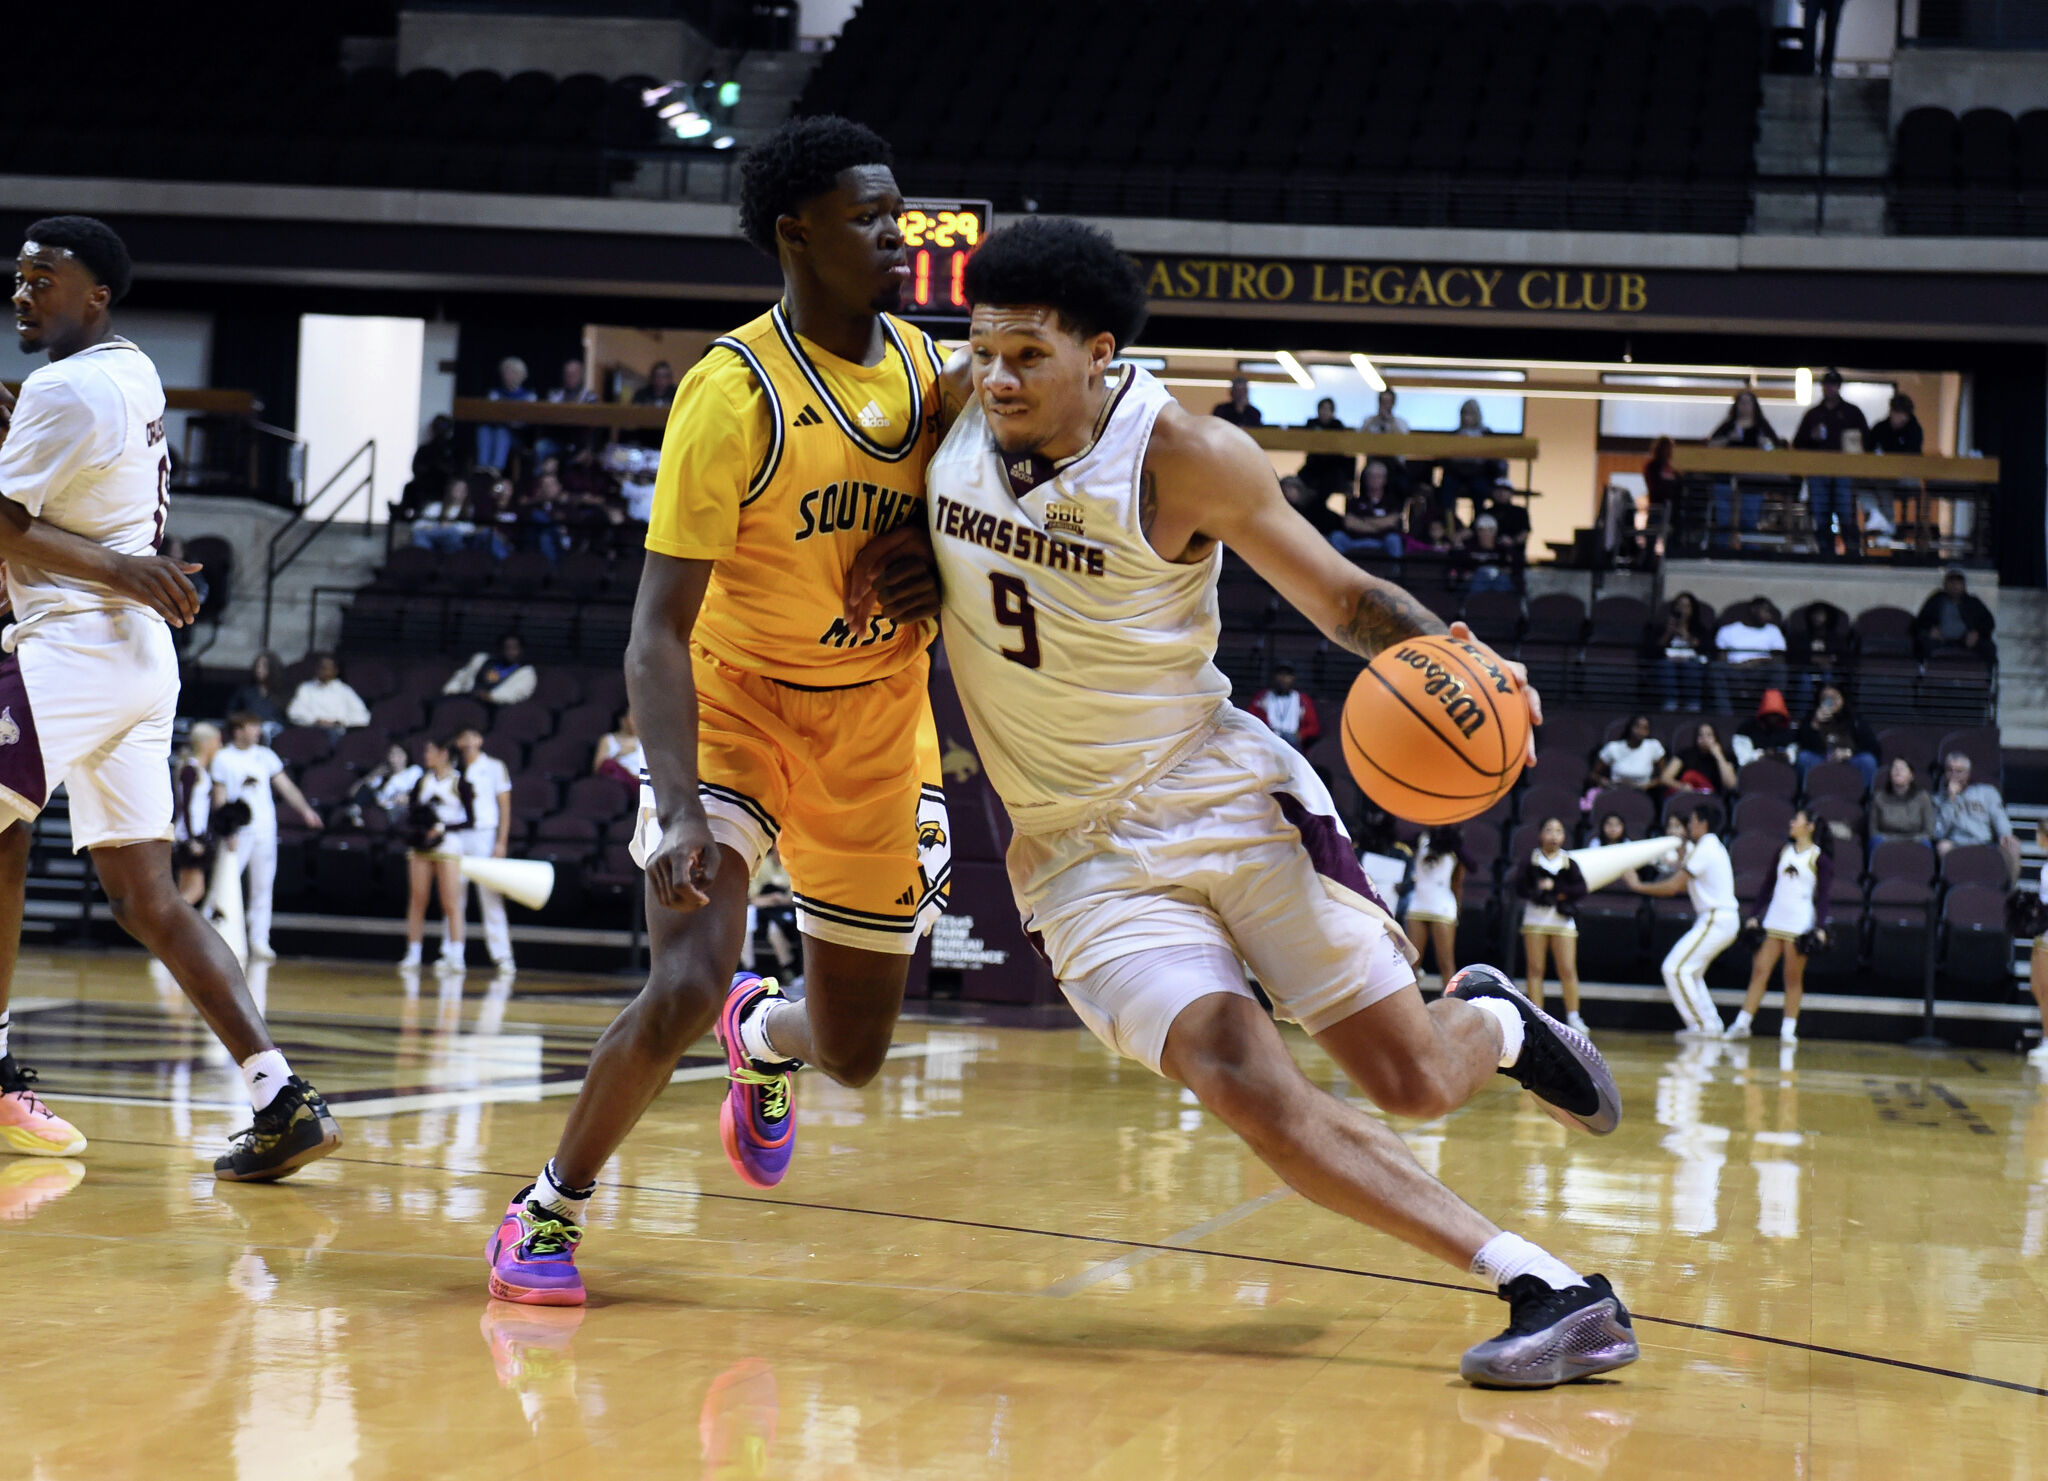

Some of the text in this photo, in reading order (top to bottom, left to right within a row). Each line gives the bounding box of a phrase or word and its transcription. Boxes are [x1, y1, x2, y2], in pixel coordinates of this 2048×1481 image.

[1133, 259, 1647, 311] ASTRO LEGACY CLUB
[1045, 502, 1084, 524] SBC
[988, 571, 1041, 670] 9
[1394, 647, 1486, 740] Wilson
